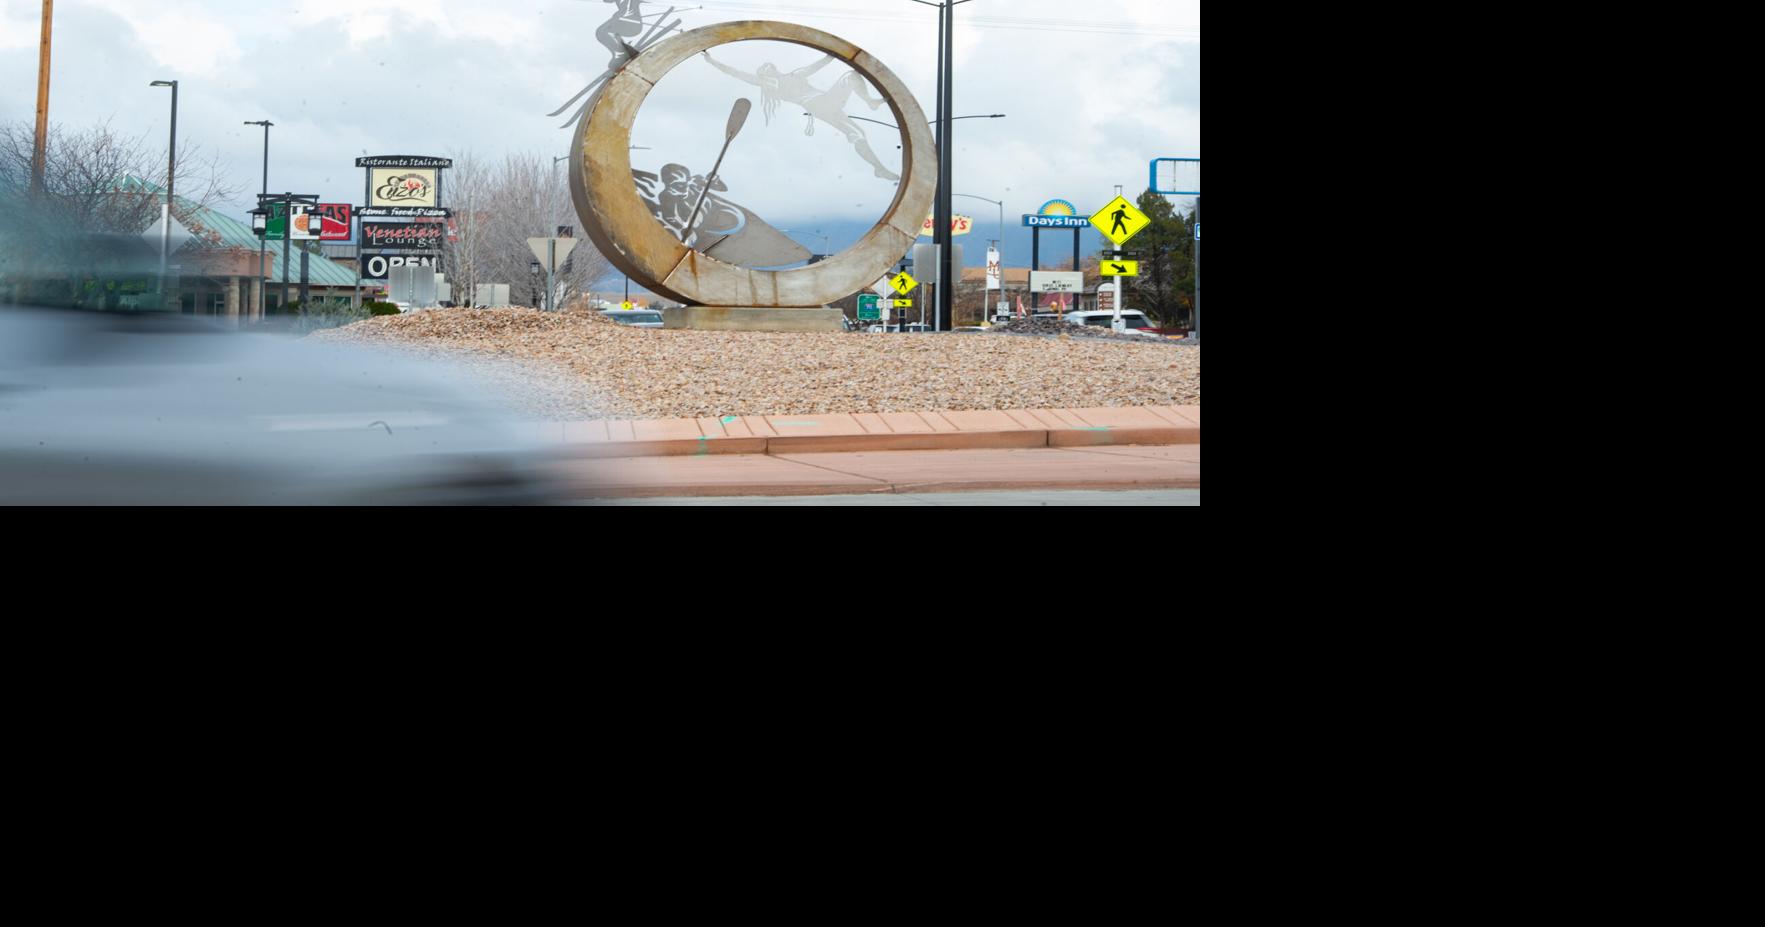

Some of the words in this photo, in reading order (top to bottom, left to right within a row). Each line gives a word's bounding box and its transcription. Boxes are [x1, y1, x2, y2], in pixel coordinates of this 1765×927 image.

[359, 157, 408, 167] Ristorante
[409, 158, 450, 167] Italiano
[1028, 216, 1063, 226] Days
[1064, 216, 1088, 226] Inn
[364, 224, 441, 239] Venetian
[373, 233, 437, 248] Lounge
